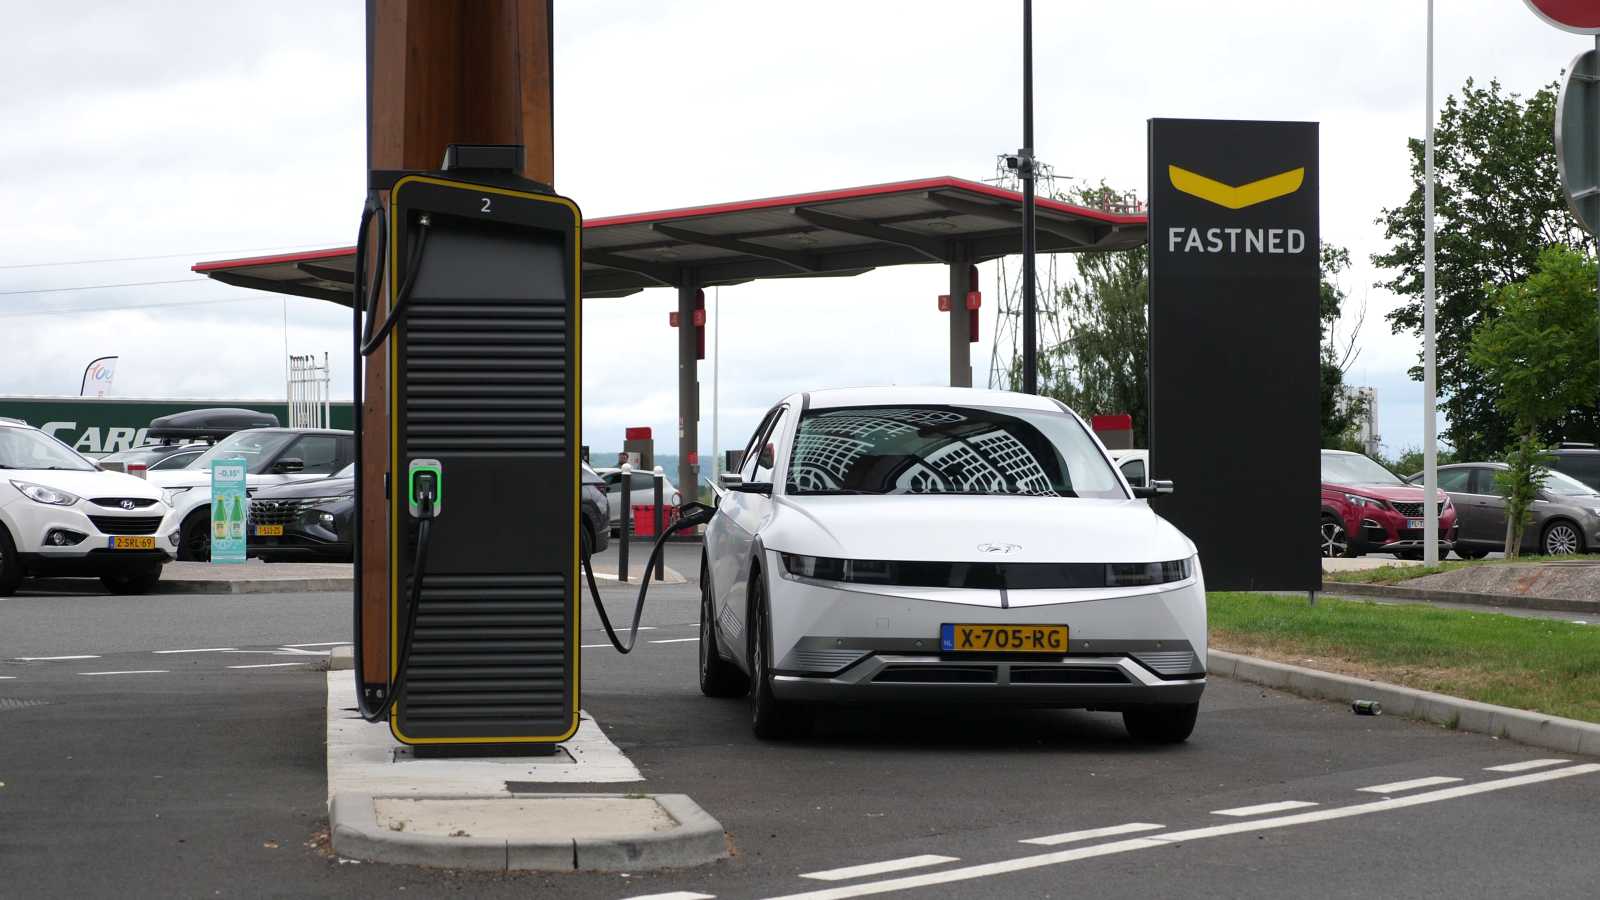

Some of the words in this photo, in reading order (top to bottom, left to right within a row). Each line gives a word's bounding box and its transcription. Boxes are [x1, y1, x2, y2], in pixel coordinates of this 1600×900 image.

[480, 198, 491, 212] 2
[1168, 227, 1305, 254] FASTNED
[961, 629, 1060, 649] X-705-RG
